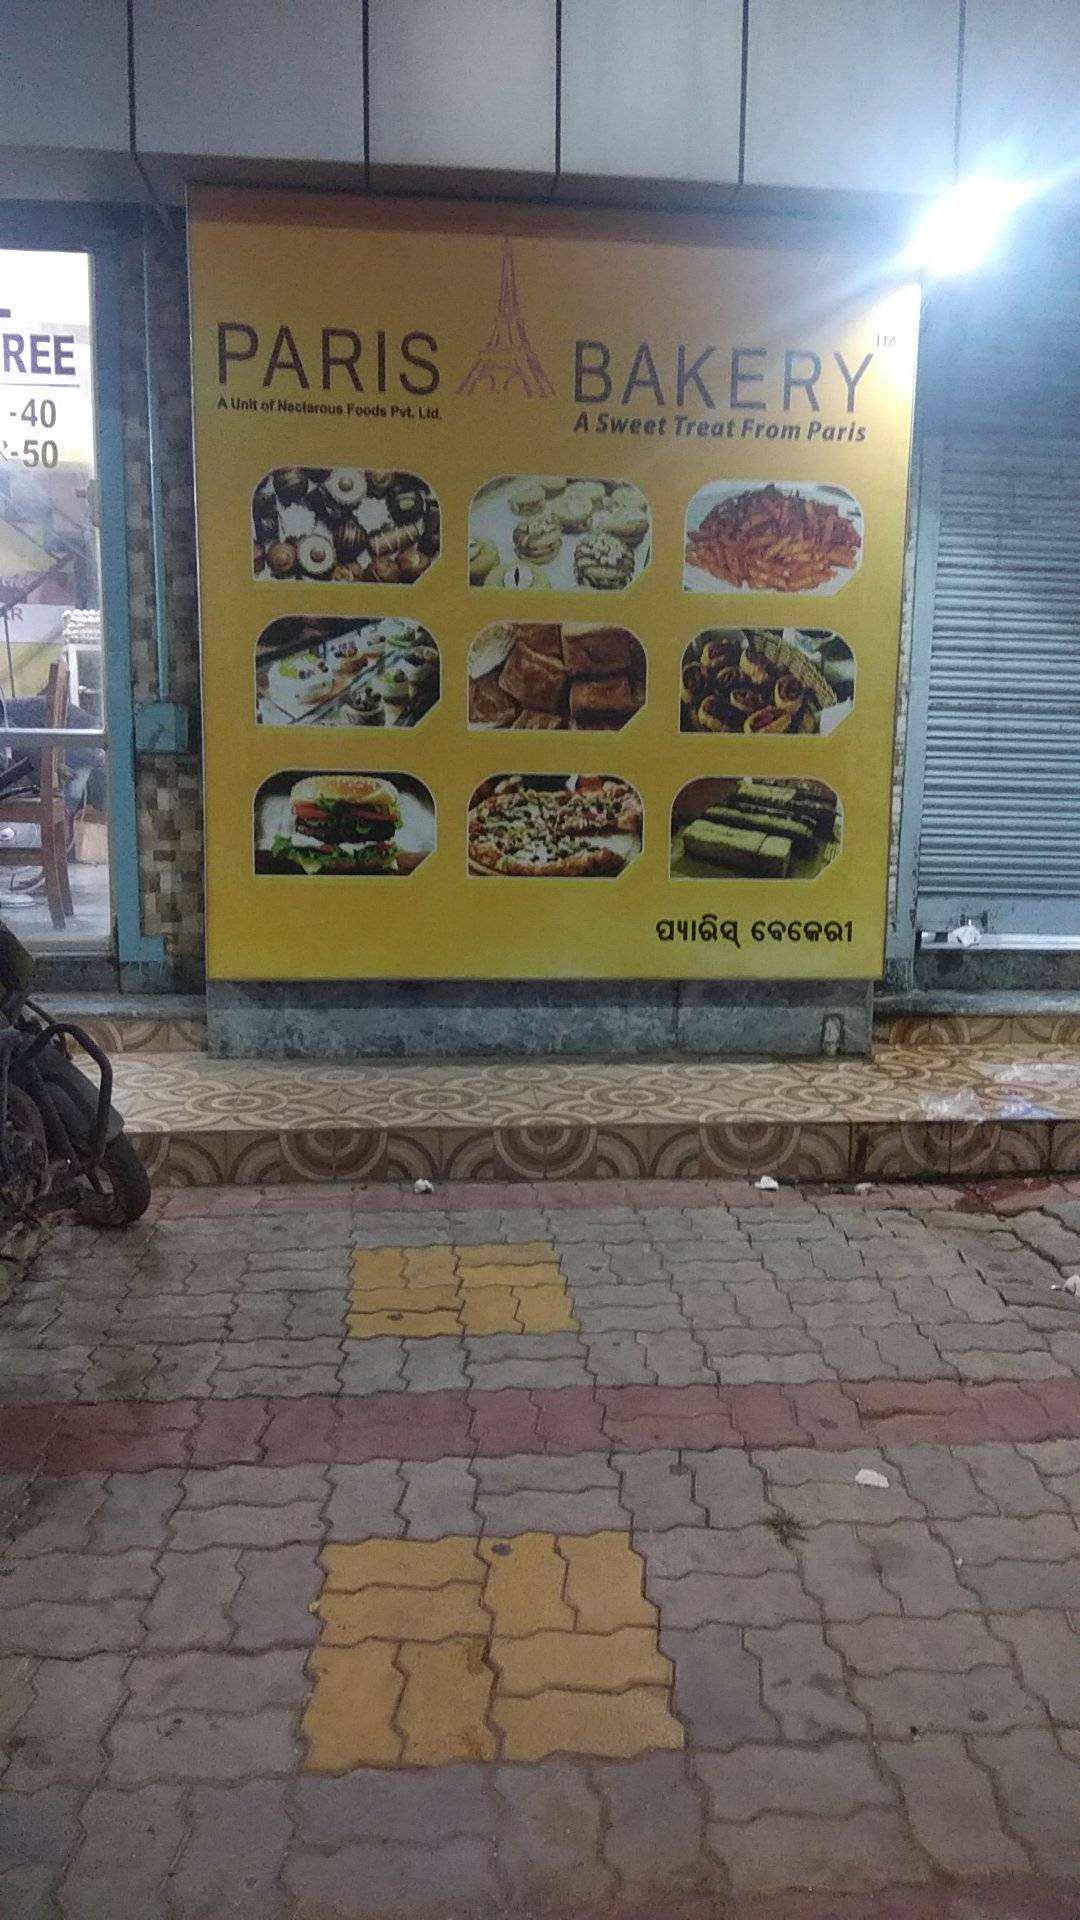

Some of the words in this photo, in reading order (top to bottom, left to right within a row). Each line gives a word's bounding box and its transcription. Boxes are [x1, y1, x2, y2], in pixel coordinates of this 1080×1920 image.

[217, 321, 441, 395] PARIS
[573, 340, 874, 413] BAKERY
[217, 397, 228, 409] A
[230, 398, 257, 411] Unit
[260, 399, 277, 411] of
[277, 400, 344, 415] Nectarous
[347, 403, 387, 417] Foods
[390, 404, 415, 418] Pvt.
[418, 406, 443, 420] Ltd.
[573, 411, 589, 433] A
[595, 413, 667, 436] Sweet
[674, 415, 735, 438] Treat
[740, 418, 800, 440] From
[806, 421, 867, 442] Paris
[655, 913, 741, 949] ପ୍ୟାରିସ୍
[751, 920, 853, 942] ବେକେରୀ
